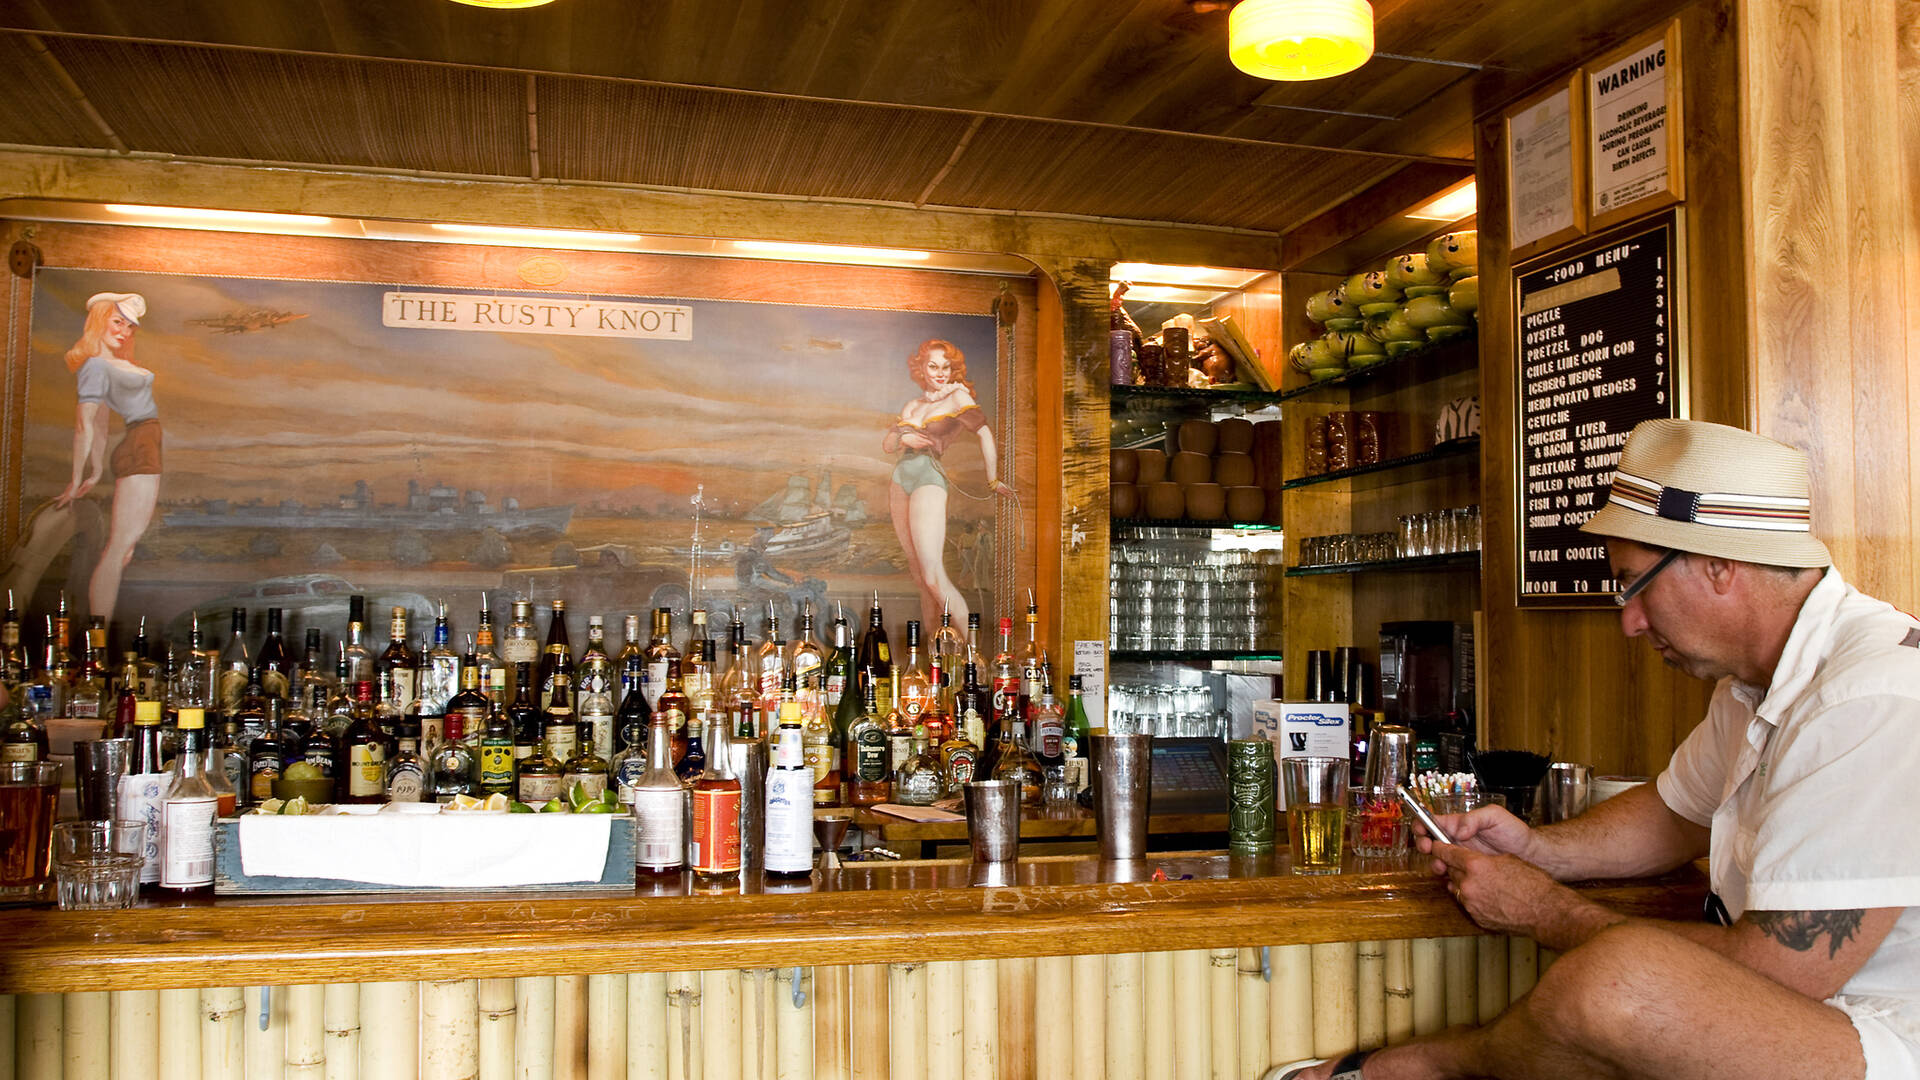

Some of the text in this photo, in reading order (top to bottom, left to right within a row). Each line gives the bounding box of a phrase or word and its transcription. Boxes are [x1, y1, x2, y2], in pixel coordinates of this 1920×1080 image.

[1598, 49, 1666, 95] WARNING
[1617, 102, 1648, 122] DRINKING
[1598, 121, 1632, 142] ALCOHOLIC
[1602, 118, 1665, 152] DURING PREGNANCY
[1617, 138, 1651, 158] CAN CAUSE
[1612, 146, 1656, 172] BIRTH DEFECTS
[1656, 256, 1662, 270] 1
[1655, 275, 1663, 289] 2
[1655, 295, 1663, 308] 3
[392, 298, 685, 333] THE RUSTY KNOT
[1527, 307, 1561, 329] PICKLE
[1655, 314, 1663, 328] 4
[1527, 323, 1565, 345] OYSTER
[1656, 333, 1664, 347] 5
[1527, 330, 1604, 362] PRETZEL DOG
[1526, 340, 1635, 379] CHILE LIME CORN COB
[1655, 352, 1663, 366] 6
[1528, 366, 1602, 396] ICEBERG WEDGE
[1656, 372, 1664, 385] 7
[1527, 378, 1637, 413] HERB POTATO WEDGES
[1656, 391, 1664, 405] 9
[1527, 410, 1570, 430] CEVICHE
[1527, 421, 1607, 447] CHICKEN LIVER
[1534, 447, 1541, 459] &
[1543, 441, 1574, 459] BACON
[1529, 458, 1577, 477] MEATLOAF
[1529, 478, 1563, 494] PULLED
[1567, 475, 1594, 490] PORK
[1529, 492, 1595, 512] FISH PO BOY
[1529, 510, 1601, 528] SHRIMP COCKT
[1529, 546, 1605, 563] WARM COOKIE
[1525, 581, 1557, 593] NOON
[1573, 579, 1588, 592] TO
